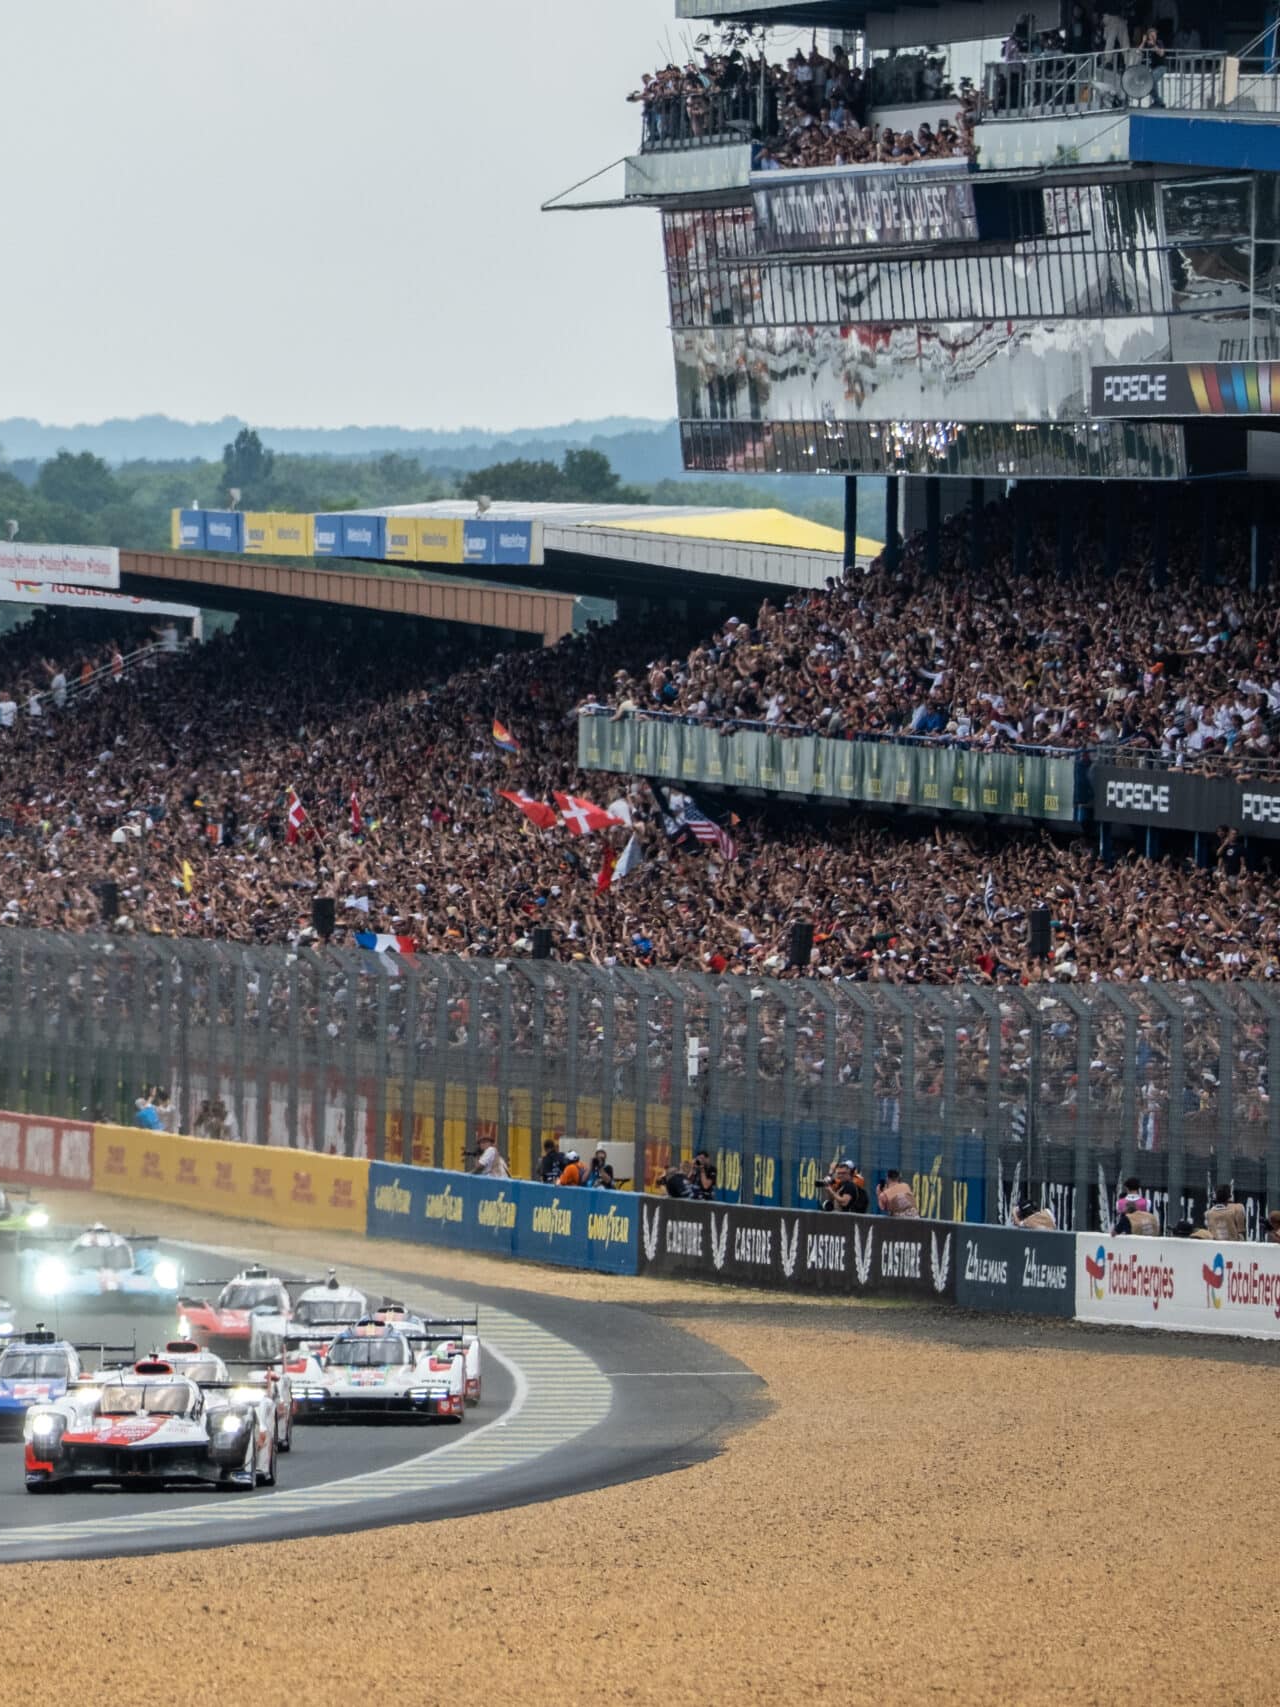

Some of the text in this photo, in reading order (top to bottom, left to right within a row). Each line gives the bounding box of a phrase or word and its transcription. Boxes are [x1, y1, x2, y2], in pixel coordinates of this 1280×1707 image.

[848, 191, 881, 231] CLUB
[881, 189, 900, 229] DE
[1104, 374, 1167, 402] PORSCHE
[1106, 781, 1170, 813] PORSCHE
[588, 1213, 630, 1243] GOODYEAR
[734, 1227, 772, 1265] CASTORE
[807, 1234, 846, 1272] CASTORE
[881, 1241, 922, 1279] CASTORE
[979, 1258, 987, 1282] LE
[1037, 1264, 1046, 1288] LE
[1107, 1252, 1175, 1311] TotalEnergies
